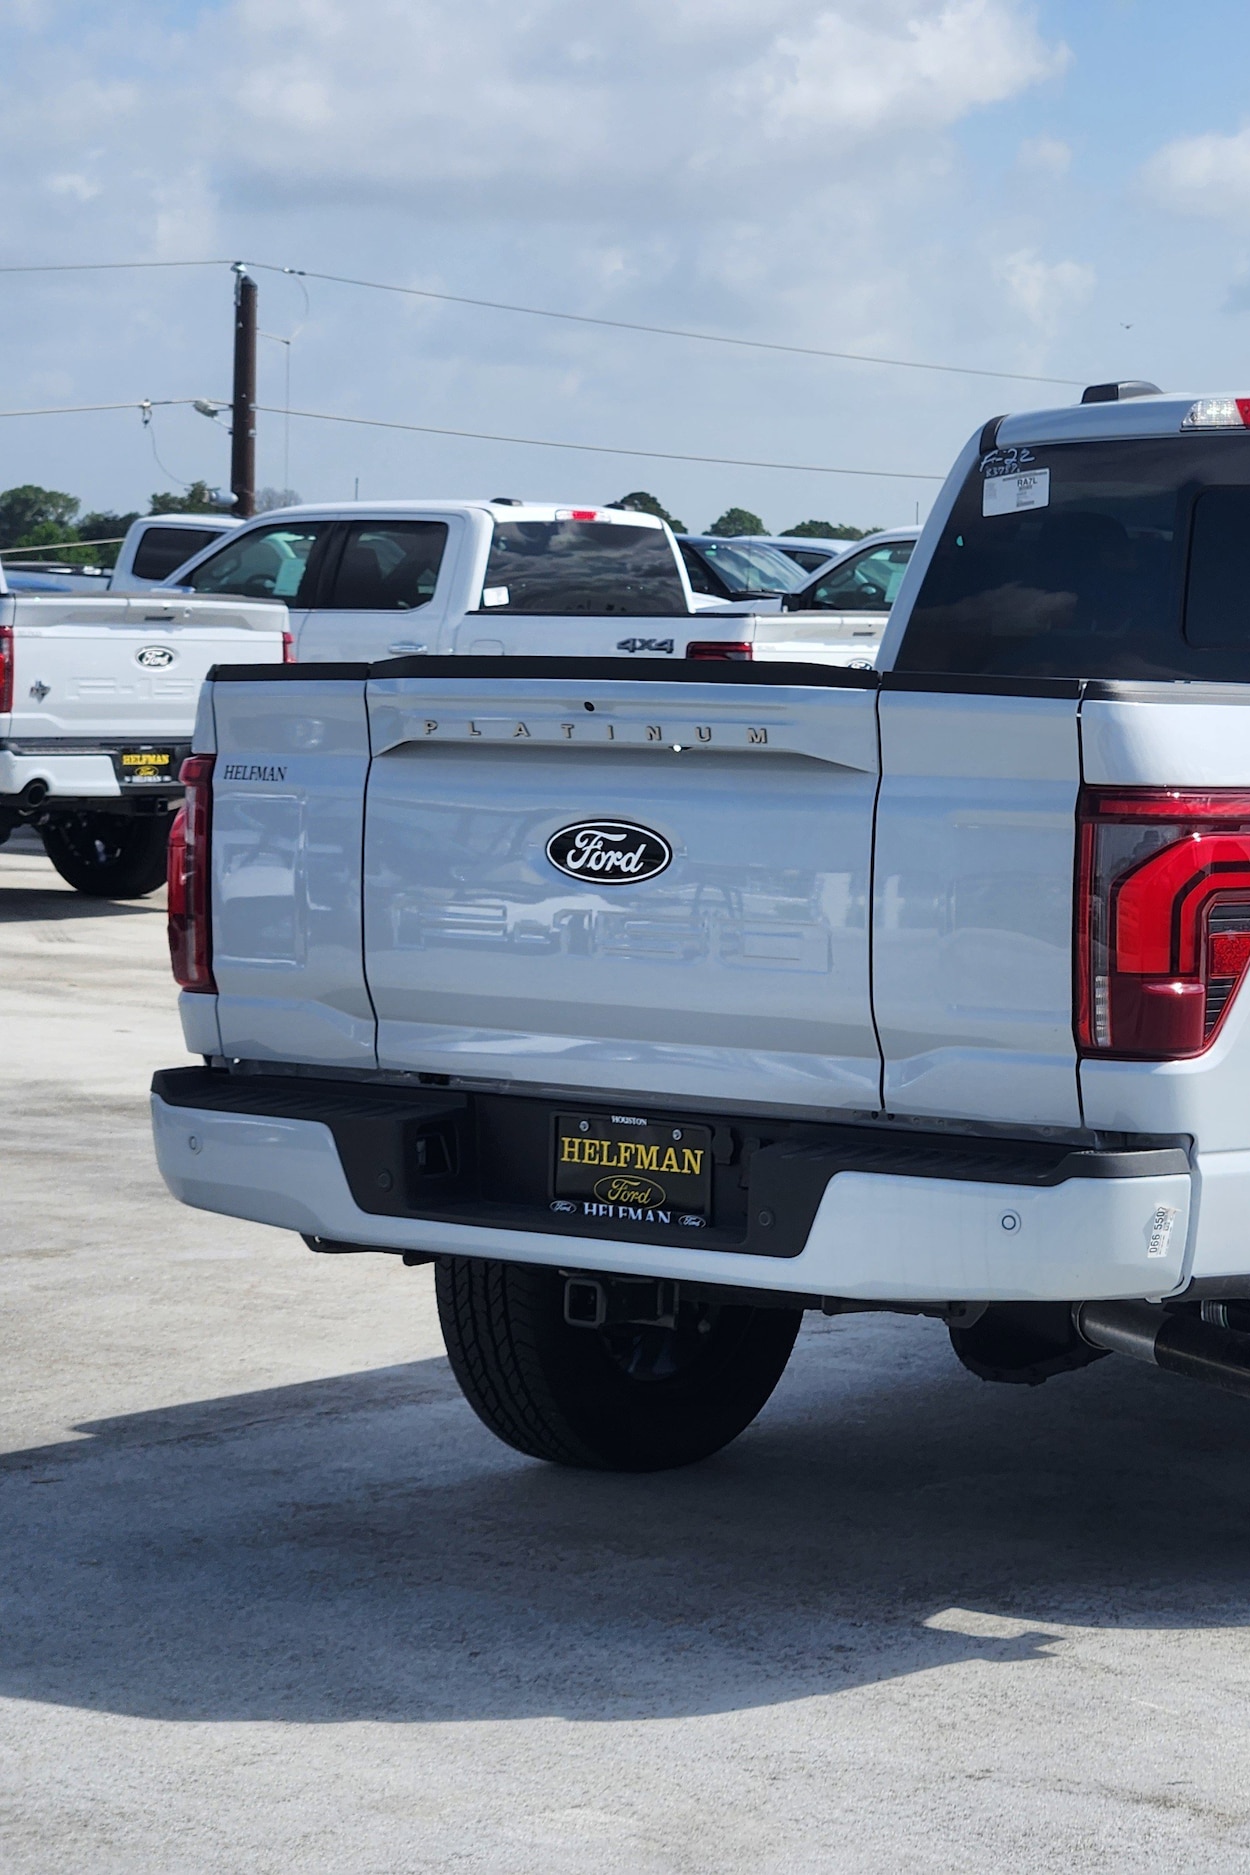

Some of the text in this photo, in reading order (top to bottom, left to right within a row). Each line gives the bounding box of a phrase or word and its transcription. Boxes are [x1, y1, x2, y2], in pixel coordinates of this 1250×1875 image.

[141, 650, 171, 666] Ford
[423, 720, 768, 744] PLATINUM
[223, 765, 288, 781] HELFMAN
[566, 829, 647, 874] Ford
[610, 1115, 648, 1126] HOUSTON
[560, 1136, 704, 1175] HELFMAN
[607, 1178, 653, 1205] Ford
